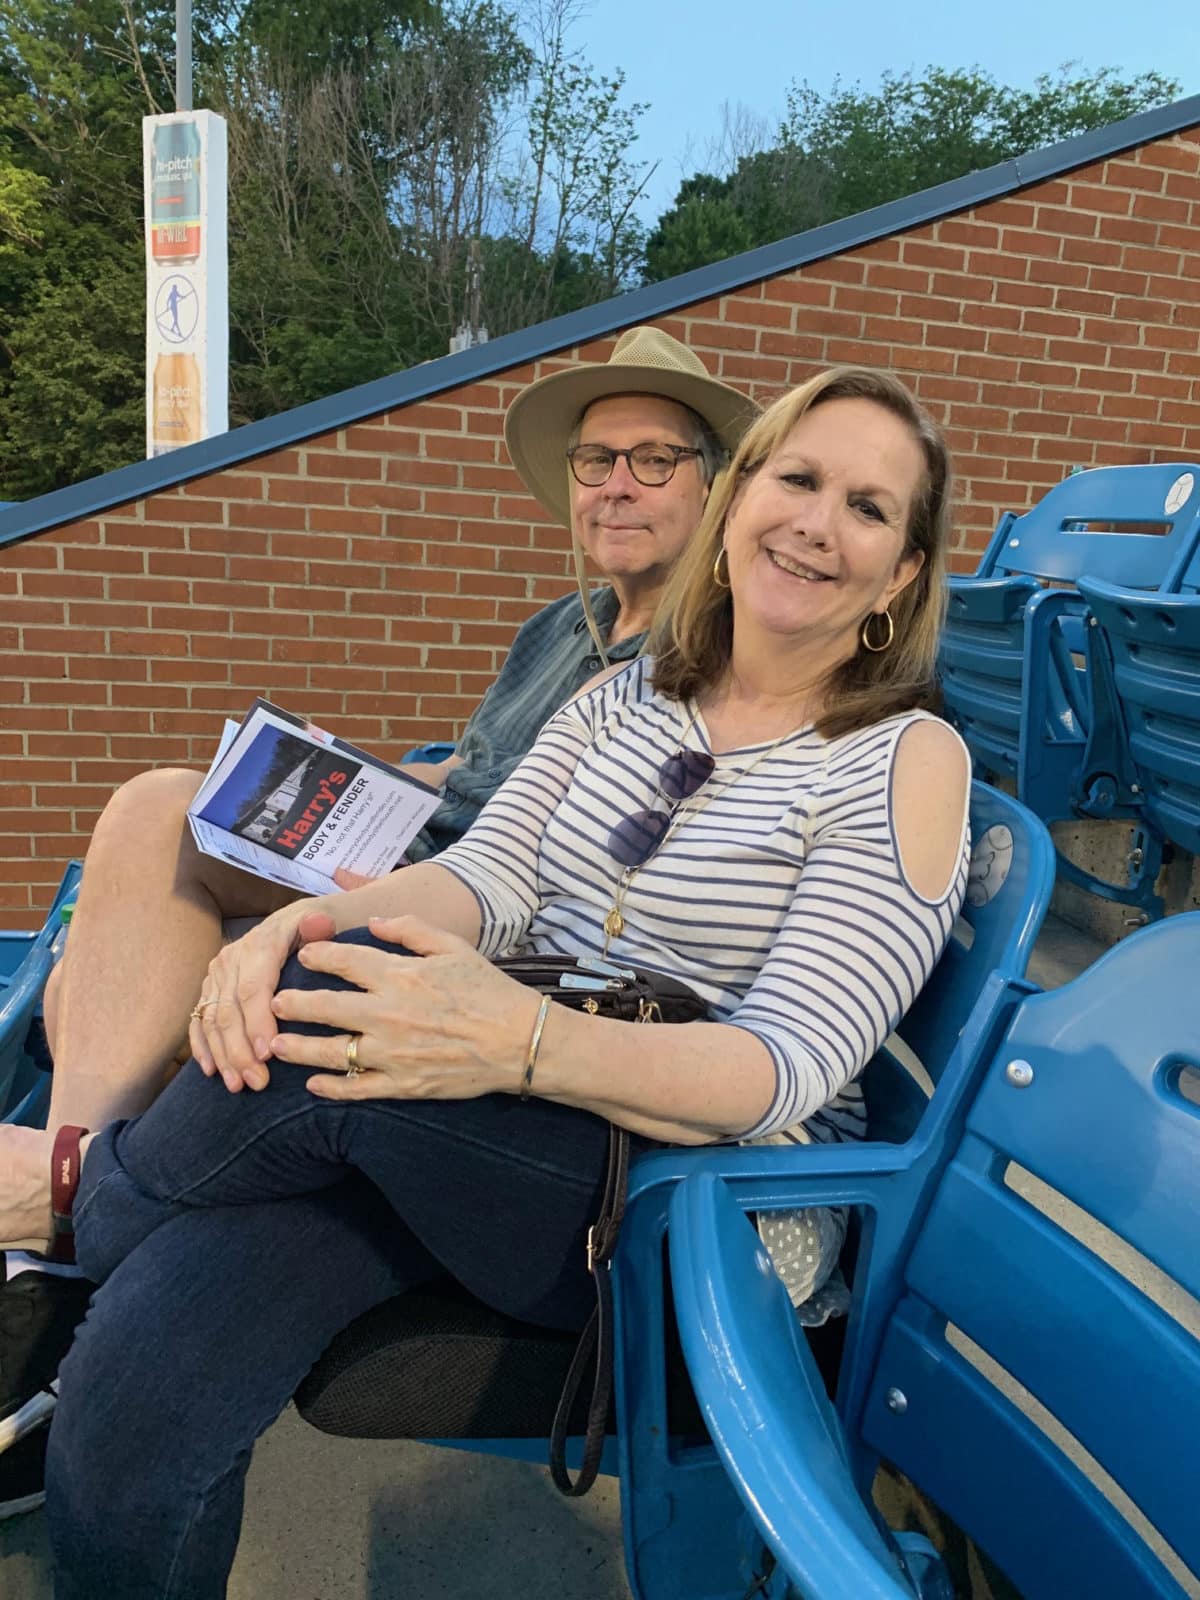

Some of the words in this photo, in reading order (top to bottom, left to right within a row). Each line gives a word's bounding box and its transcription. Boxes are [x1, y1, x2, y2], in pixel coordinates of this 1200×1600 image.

[157, 156, 192, 173] hi-pitch
[276, 770, 348, 849] Harry's
[302, 829, 328, 861] BODY
[327, 818, 338, 832] &
[335, 777, 370, 822] FENDER
